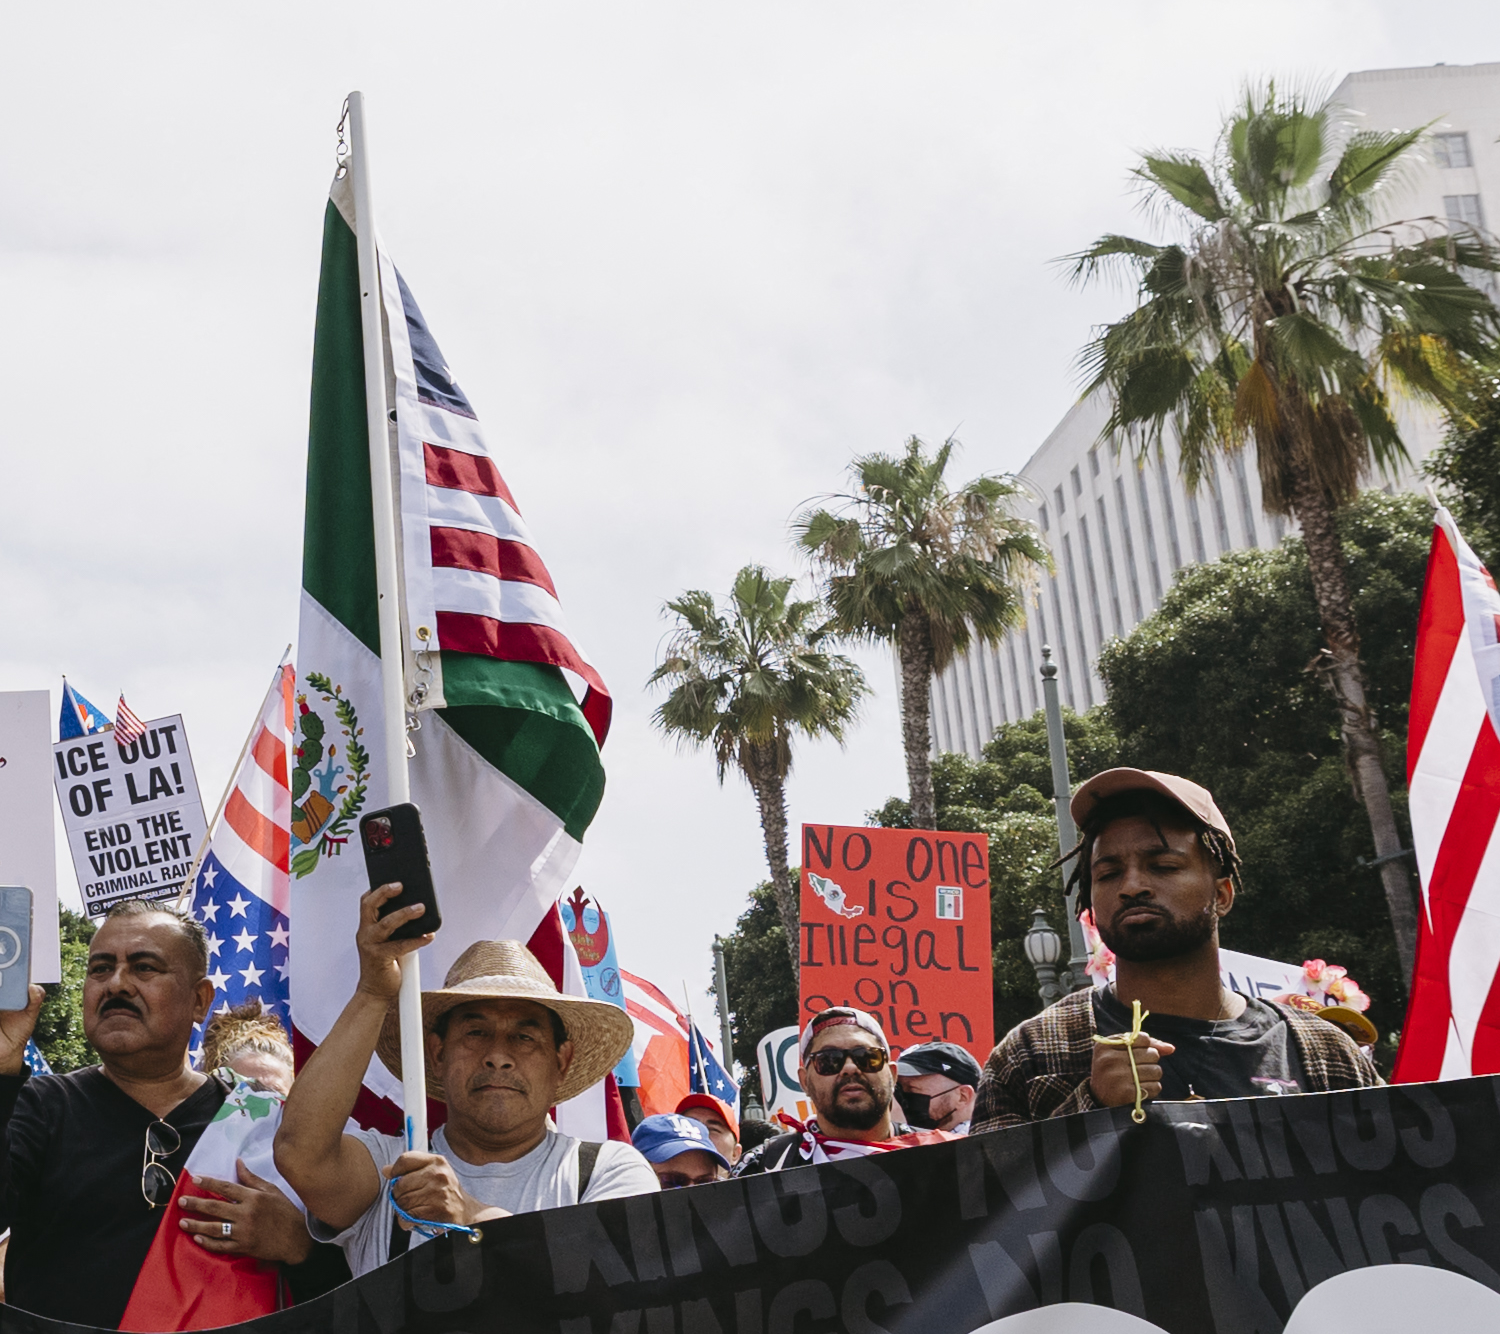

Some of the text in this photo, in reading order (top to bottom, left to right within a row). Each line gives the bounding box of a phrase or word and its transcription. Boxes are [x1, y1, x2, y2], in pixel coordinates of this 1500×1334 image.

[55, 725, 178, 780] ICE OUT
[68, 762, 185, 818] OF LA!
[84, 811, 184, 852] END THE
[88, 833, 192, 878] VIOLENT
[85, 859, 202, 898] CRIMINAL RAID
[854, 978, 919, 1006] on
